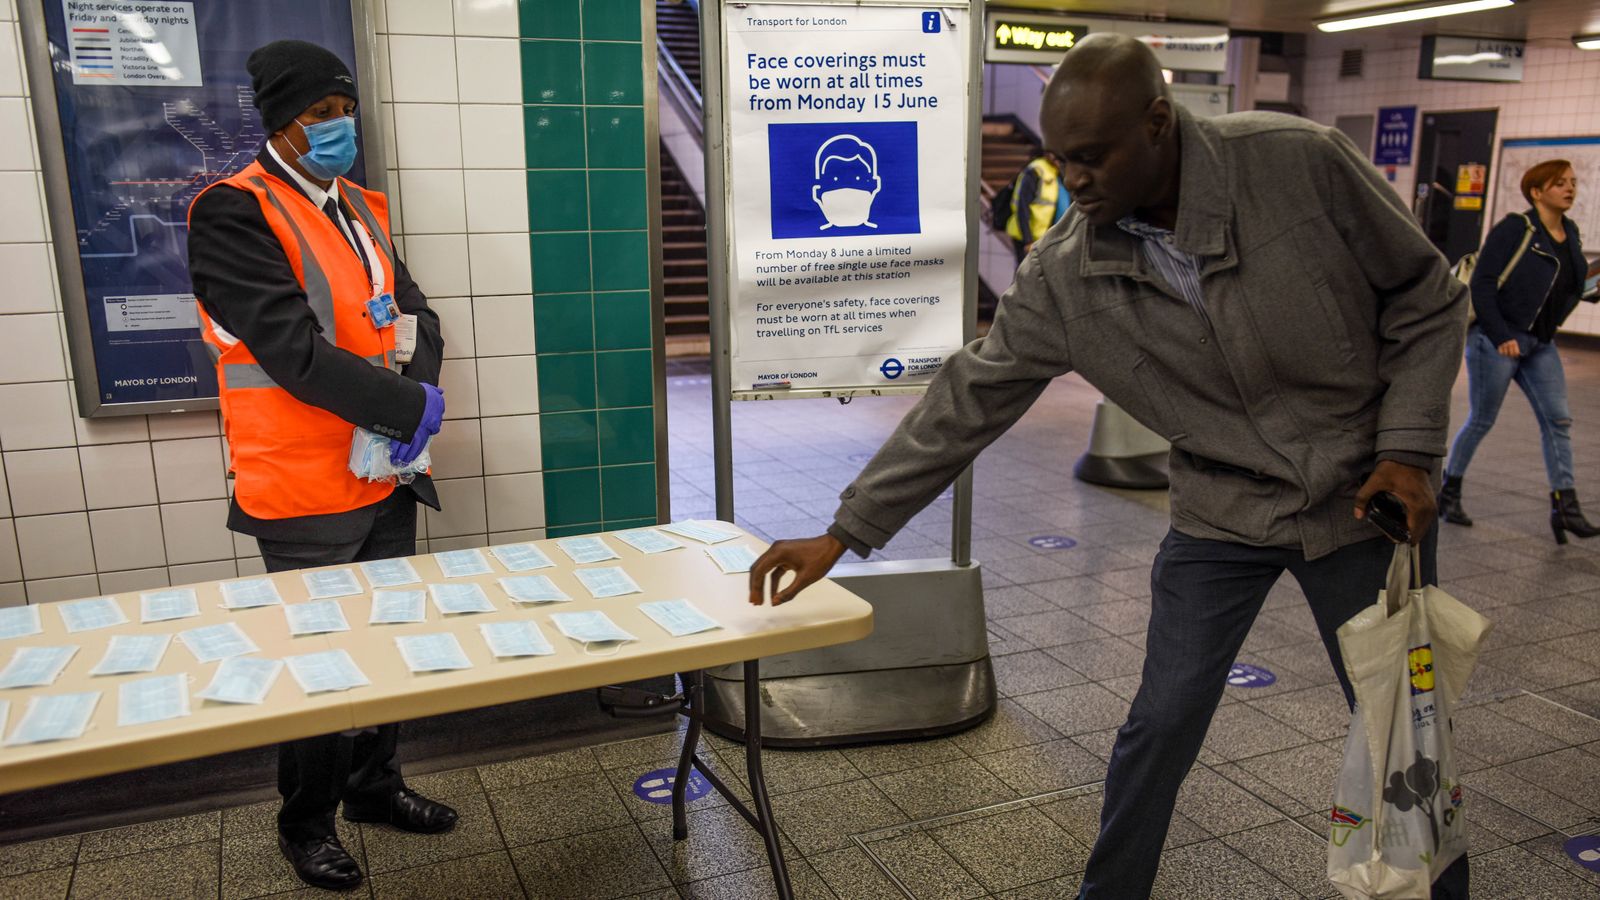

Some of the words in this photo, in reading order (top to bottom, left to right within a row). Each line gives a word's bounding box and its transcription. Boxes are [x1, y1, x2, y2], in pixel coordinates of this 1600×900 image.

[68, 2, 93, 12] Night
[96, 4, 133, 12] services
[135, 5, 170, 14] operate
[69, 13, 97, 23] Friday
[161, 16, 189, 25] nights
[747, 17, 793, 27] Transport
[796, 17, 809, 26] for
[812, 17, 847, 26] London
[1011, 26, 1046, 49] Way
[1046, 31, 1074, 48] out
[748, 53, 788, 69] Face
[794, 52, 877, 71] coverings
[883, 53, 926, 68] must
[749, 74, 770, 90] be
[776, 76, 821, 89] worn
[827, 75, 844, 89] at
[850, 73, 870, 88] all
[875, 72, 923, 88] times
[749, 95, 791, 111] from
[797, 93, 866, 113] Monday
[874, 93, 891, 109] 15
[897, 93, 938, 108] June
[755, 251, 783, 260] From
[786, 249, 828, 260] Monday
[831, 248, 837, 257] 8
[839, 248, 864, 257] June
[875, 246, 911, 256] limited
[756, 264, 797, 274] number
[800, 262, 811, 272] of
[814, 262, 835, 271] free
[837, 261, 867, 271] single
[870, 261, 888, 269] use
[890, 259, 911, 268] face
[913, 258, 945, 266] masks
[757, 277, 776, 287] will
[779, 277, 792, 286] be
[794, 275, 839, 285] available
[841, 274, 852, 282] at
[854, 272, 873, 281] this
[875, 270, 911, 280] station
[756, 303, 774, 312] For
[776, 300, 831, 311] everyone's
[833, 297, 867, 309] safety,
[870, 296, 891, 306] face
[893, 295, 940, 305] coverings
[756, 315, 784, 325] must
[785, 315, 799, 323] be
[801, 313, 828, 322] worn
[830, 312, 841, 321] at
[843, 311, 856, 320] all
[858, 311, 887, 320] times
[889, 309, 917, 318] when
[756, 327, 806, 338] travelling
[807, 327, 821, 335] on
[823, 324, 840, 334] TfL
[842, 324, 883, 334] services
[114, 379, 145, 387] MAYOR
[160, 376, 198, 385] LONDON
